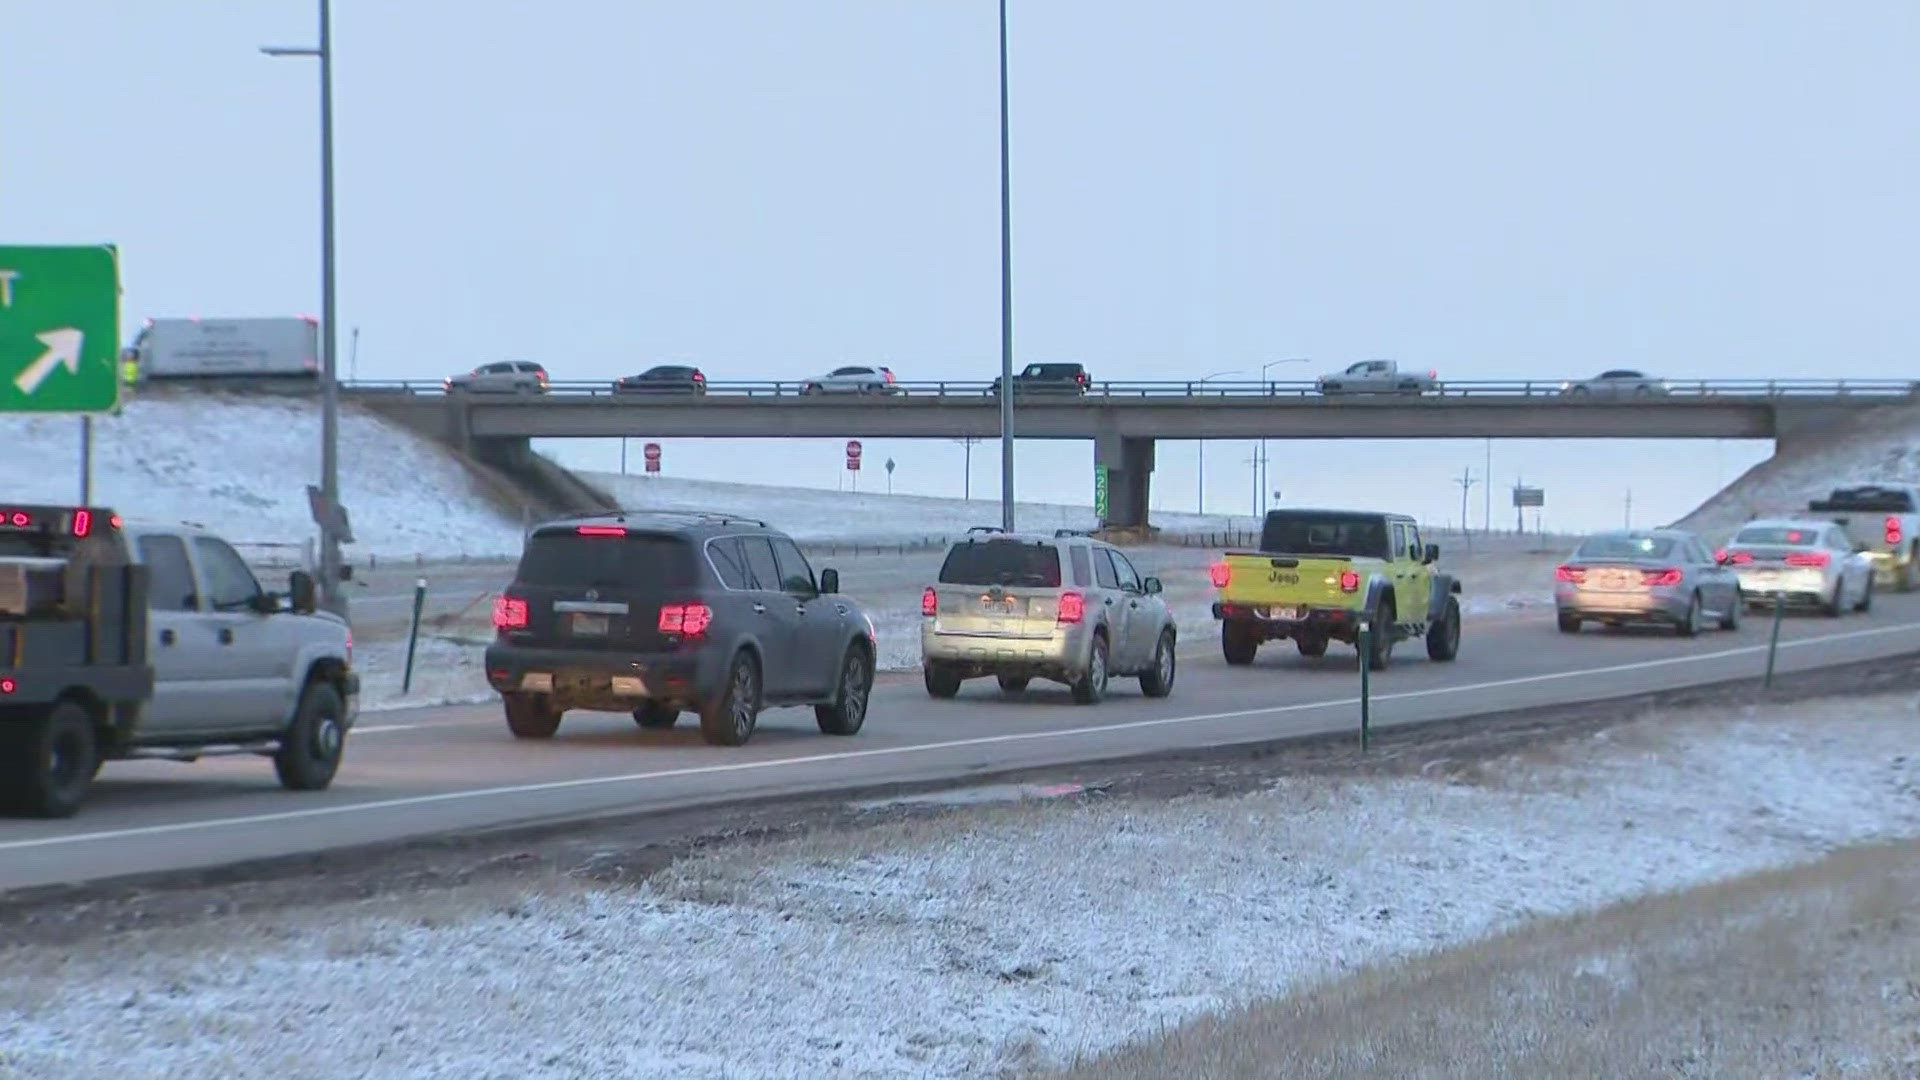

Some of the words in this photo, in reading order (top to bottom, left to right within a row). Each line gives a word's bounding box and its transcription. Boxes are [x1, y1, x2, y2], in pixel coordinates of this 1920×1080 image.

[0, 270, 20, 307] T
[1096, 476, 1105, 516] 292
[1268, 571, 1299, 585] Jeep
